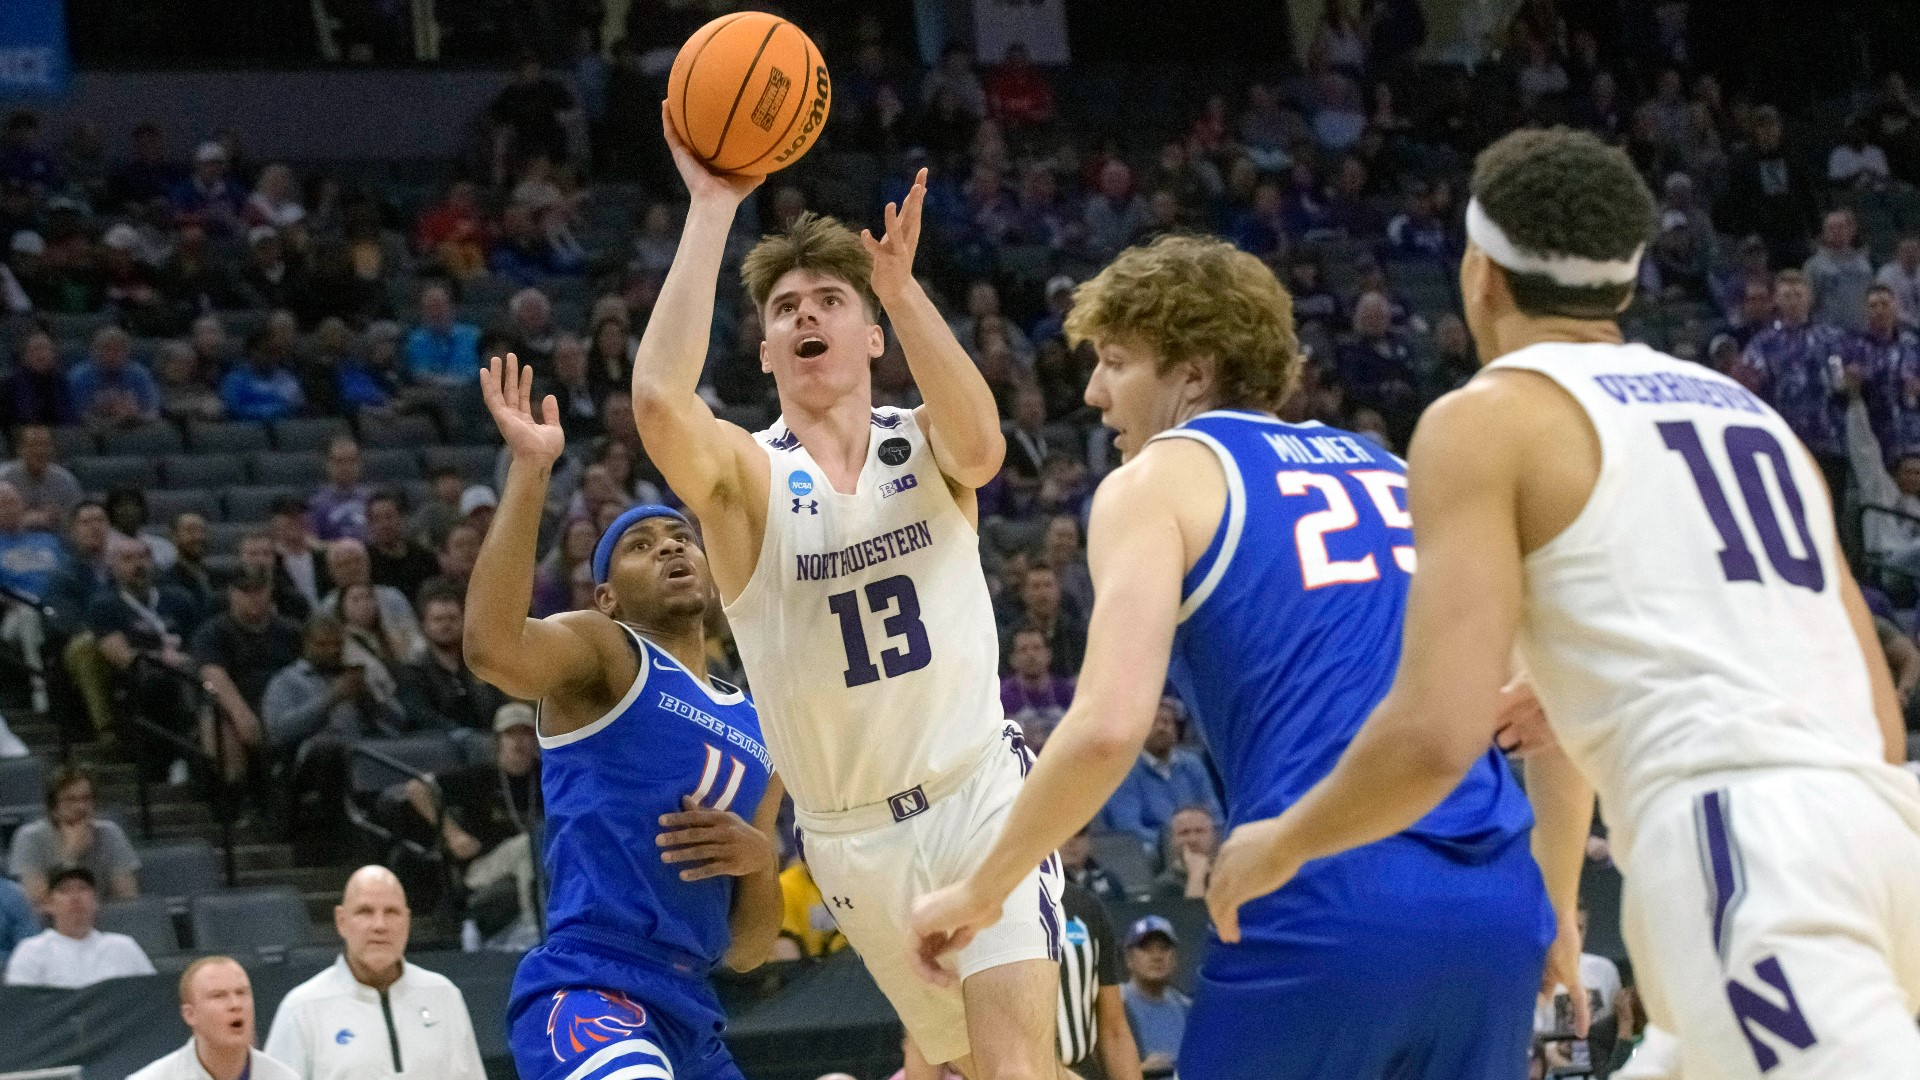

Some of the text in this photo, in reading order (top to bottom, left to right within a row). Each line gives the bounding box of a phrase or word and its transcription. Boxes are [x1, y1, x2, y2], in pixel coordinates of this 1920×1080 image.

[1260, 431, 1376, 464] MILNER
[792, 481, 812, 490] NCAA
[1654, 420, 1824, 593] 10
[796, 520, 933, 581] NORTHWESTERN
[1276, 469, 1418, 591] 25
[828, 574, 932, 688] 13
[658, 691, 726, 736] BOISE
[691, 742, 746, 811] 11
[899, 794, 918, 814] N
[1726, 956, 1818, 1073] N
